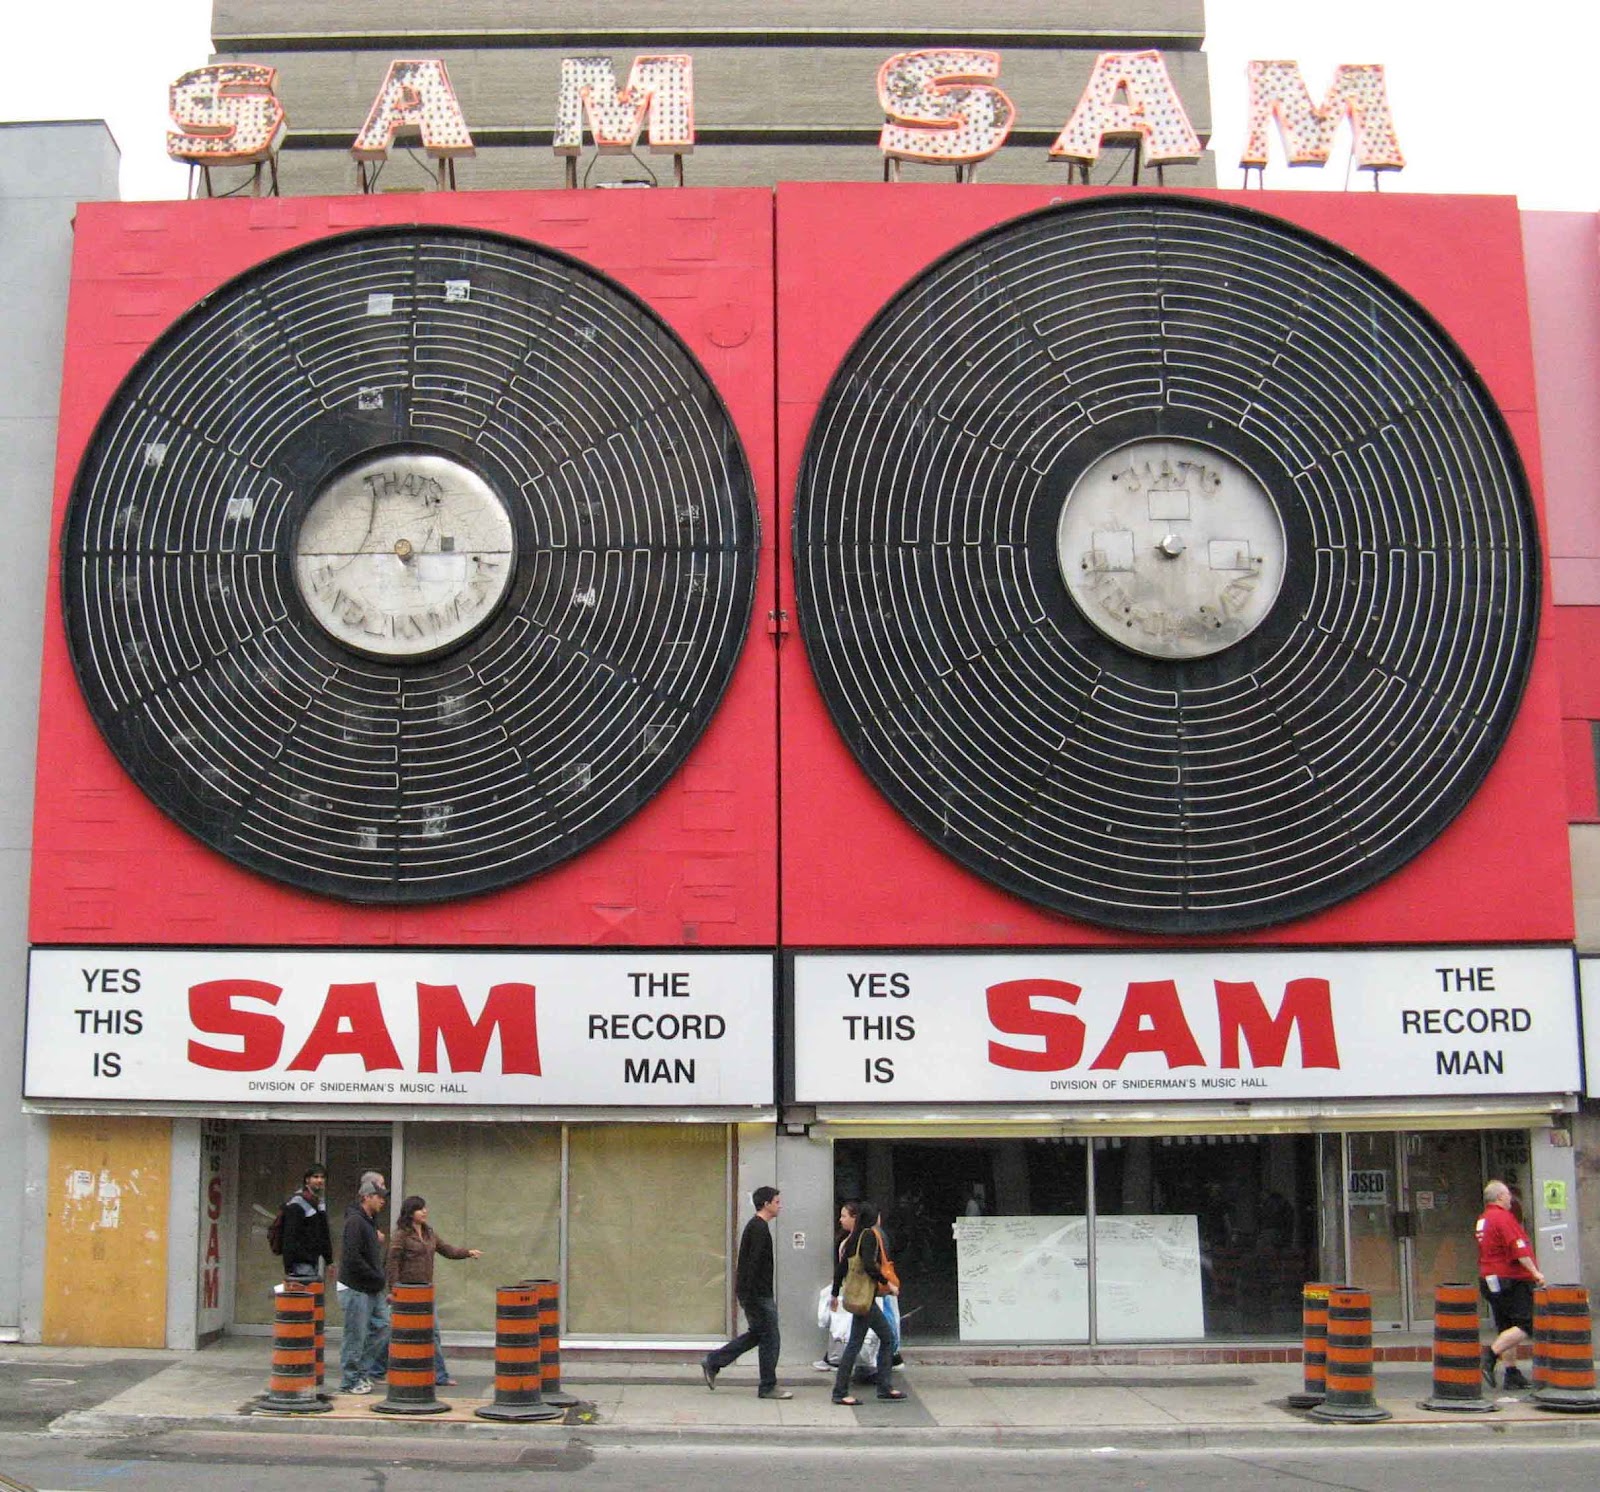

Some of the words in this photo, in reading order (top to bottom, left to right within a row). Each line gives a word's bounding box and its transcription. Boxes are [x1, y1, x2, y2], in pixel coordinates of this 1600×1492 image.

[166, 54, 696, 165] SAM
[877, 49, 1406, 172] SAM
[83, 969, 140, 994] YES
[628, 973, 689, 997] THE
[848, 973, 909, 998] YES
[1436, 967, 1494, 991] THE
[75, 1009, 142, 1034] THIS
[188, 979, 541, 1076] SAM
[589, 1014, 726, 1040] RECORD
[843, 1016, 915, 1041] THIS
[986, 978, 1340, 1073] SAM
[1402, 1008, 1531, 1034] RECORD
[94, 1053, 121, 1078] IS
[625, 1059, 694, 1083] MAN
[866, 1058, 894, 1083] IS
[1437, 1051, 1503, 1075] MAN
[248, 1081, 295, 1092] DIVISION
[300, 1082, 315, 1092] OF
[320, 1082, 395, 1093] SNIDERMAN'S
[399, 1083, 436, 1093] MUSIC
[440, 1084, 468, 1094] HALL
[1050, 1080, 1098, 1090] DIVISION
[1102, 1080, 1117, 1089] OF
[1122, 1079, 1197, 1089] SNIDERMAN'S
[1201, 1078, 1236, 1088] MUSIC
[1241, 1078, 1268, 1087] HALL
[1350, 1173, 1384, 1193] OSED
